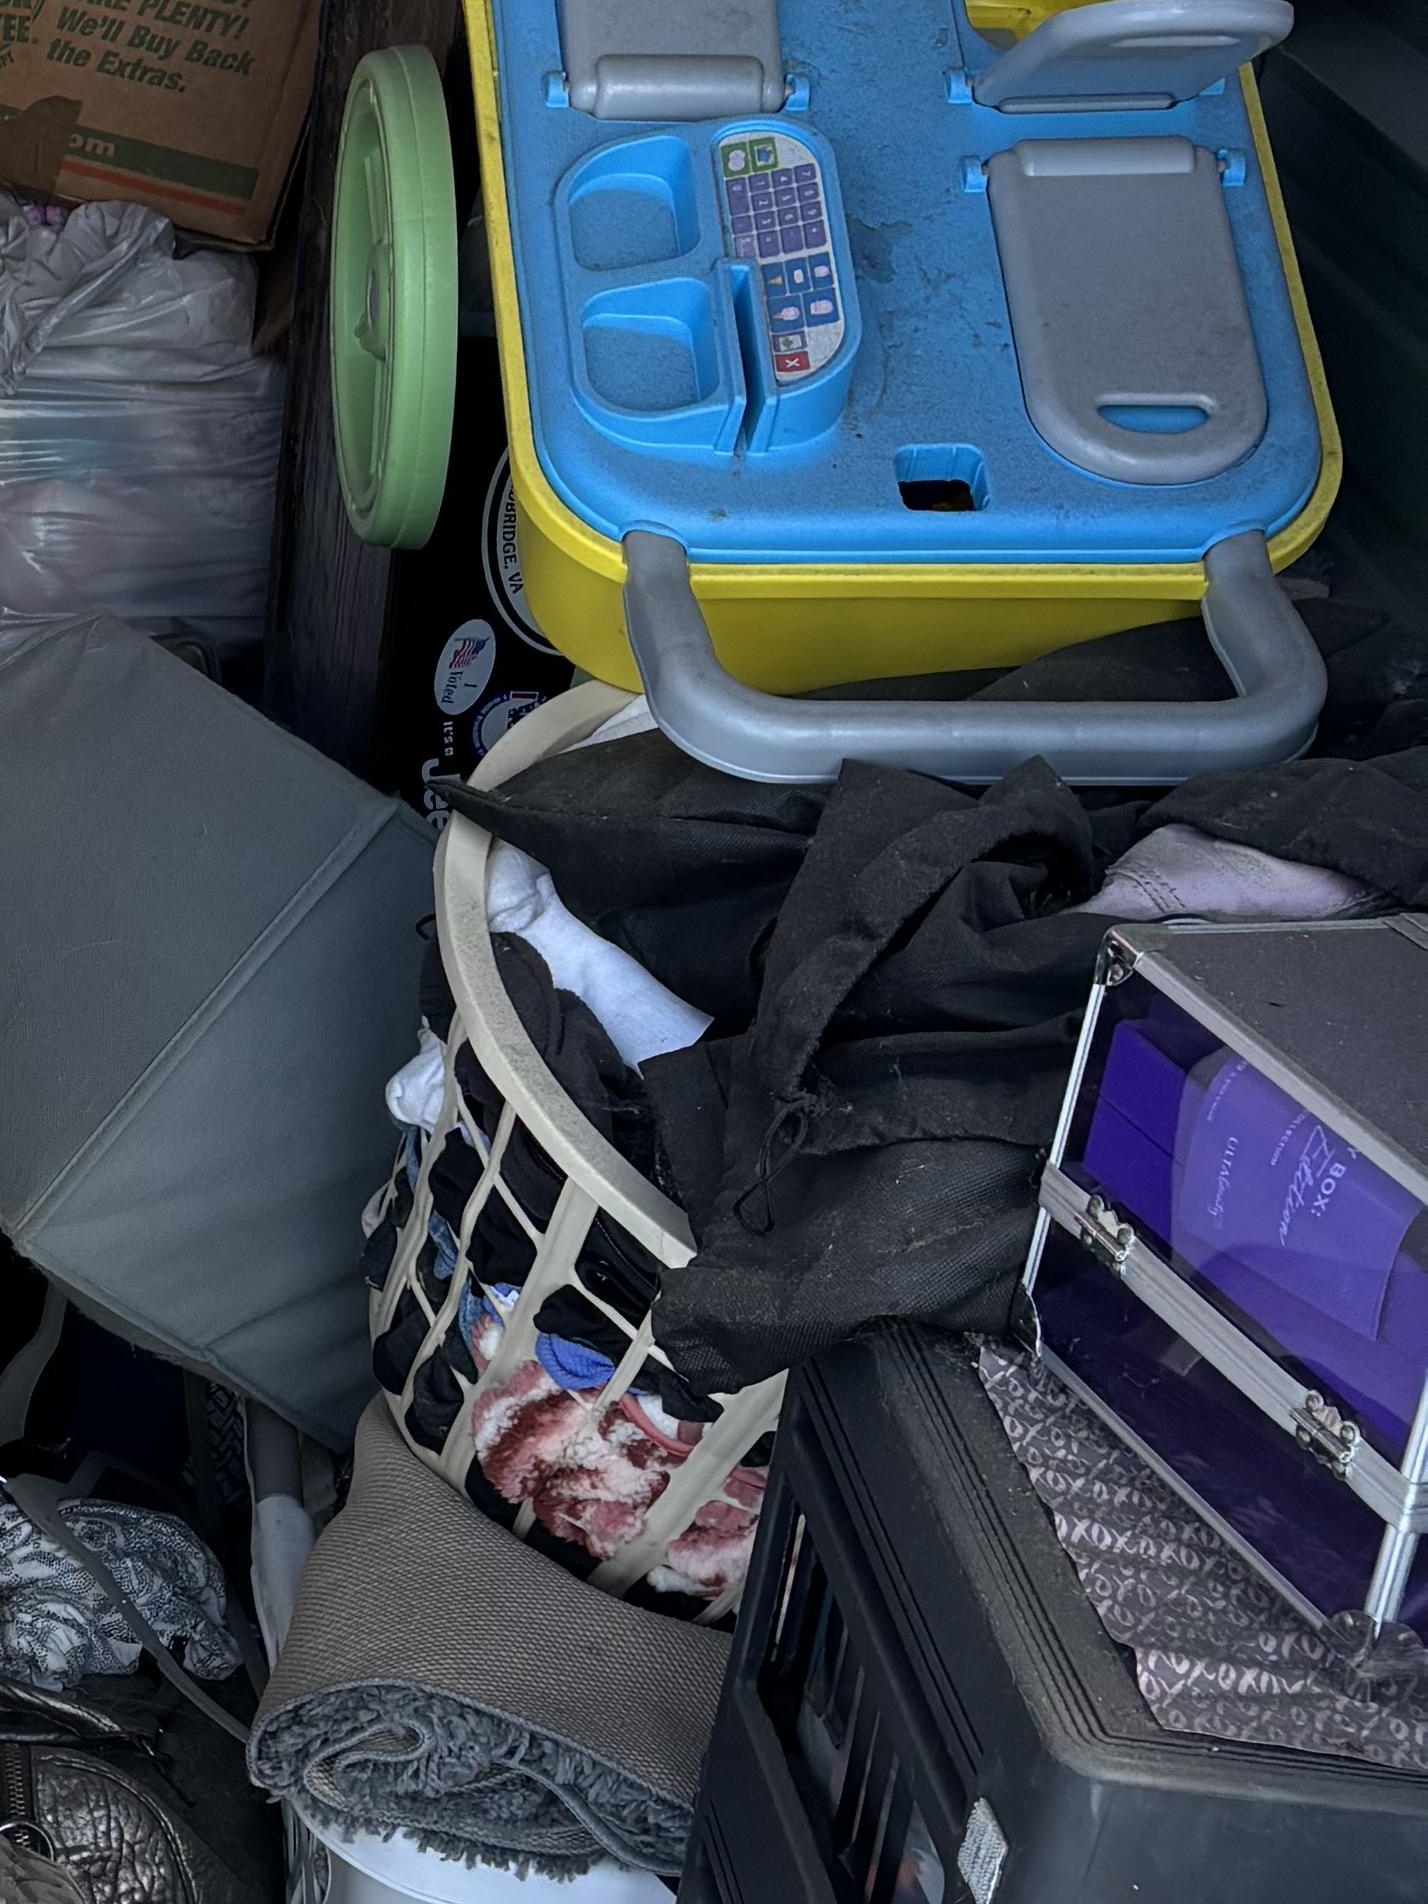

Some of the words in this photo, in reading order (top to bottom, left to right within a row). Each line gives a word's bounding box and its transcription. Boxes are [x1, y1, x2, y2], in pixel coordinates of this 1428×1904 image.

[46, 38, 92, 67] the
[96, 49, 186, 93] Extras.
[56, 6, 125, 43] We'll
[127, 24, 182, 61] Buy
[184, 38, 256, 76] Back
[508, 572, 523, 594] VA
[440, 670, 463, 704] Voted
[443, 721, 453, 743] It's
[1279, 1125, 1336, 1246] Edition
[1310, 1162, 1347, 1217] BOX:
